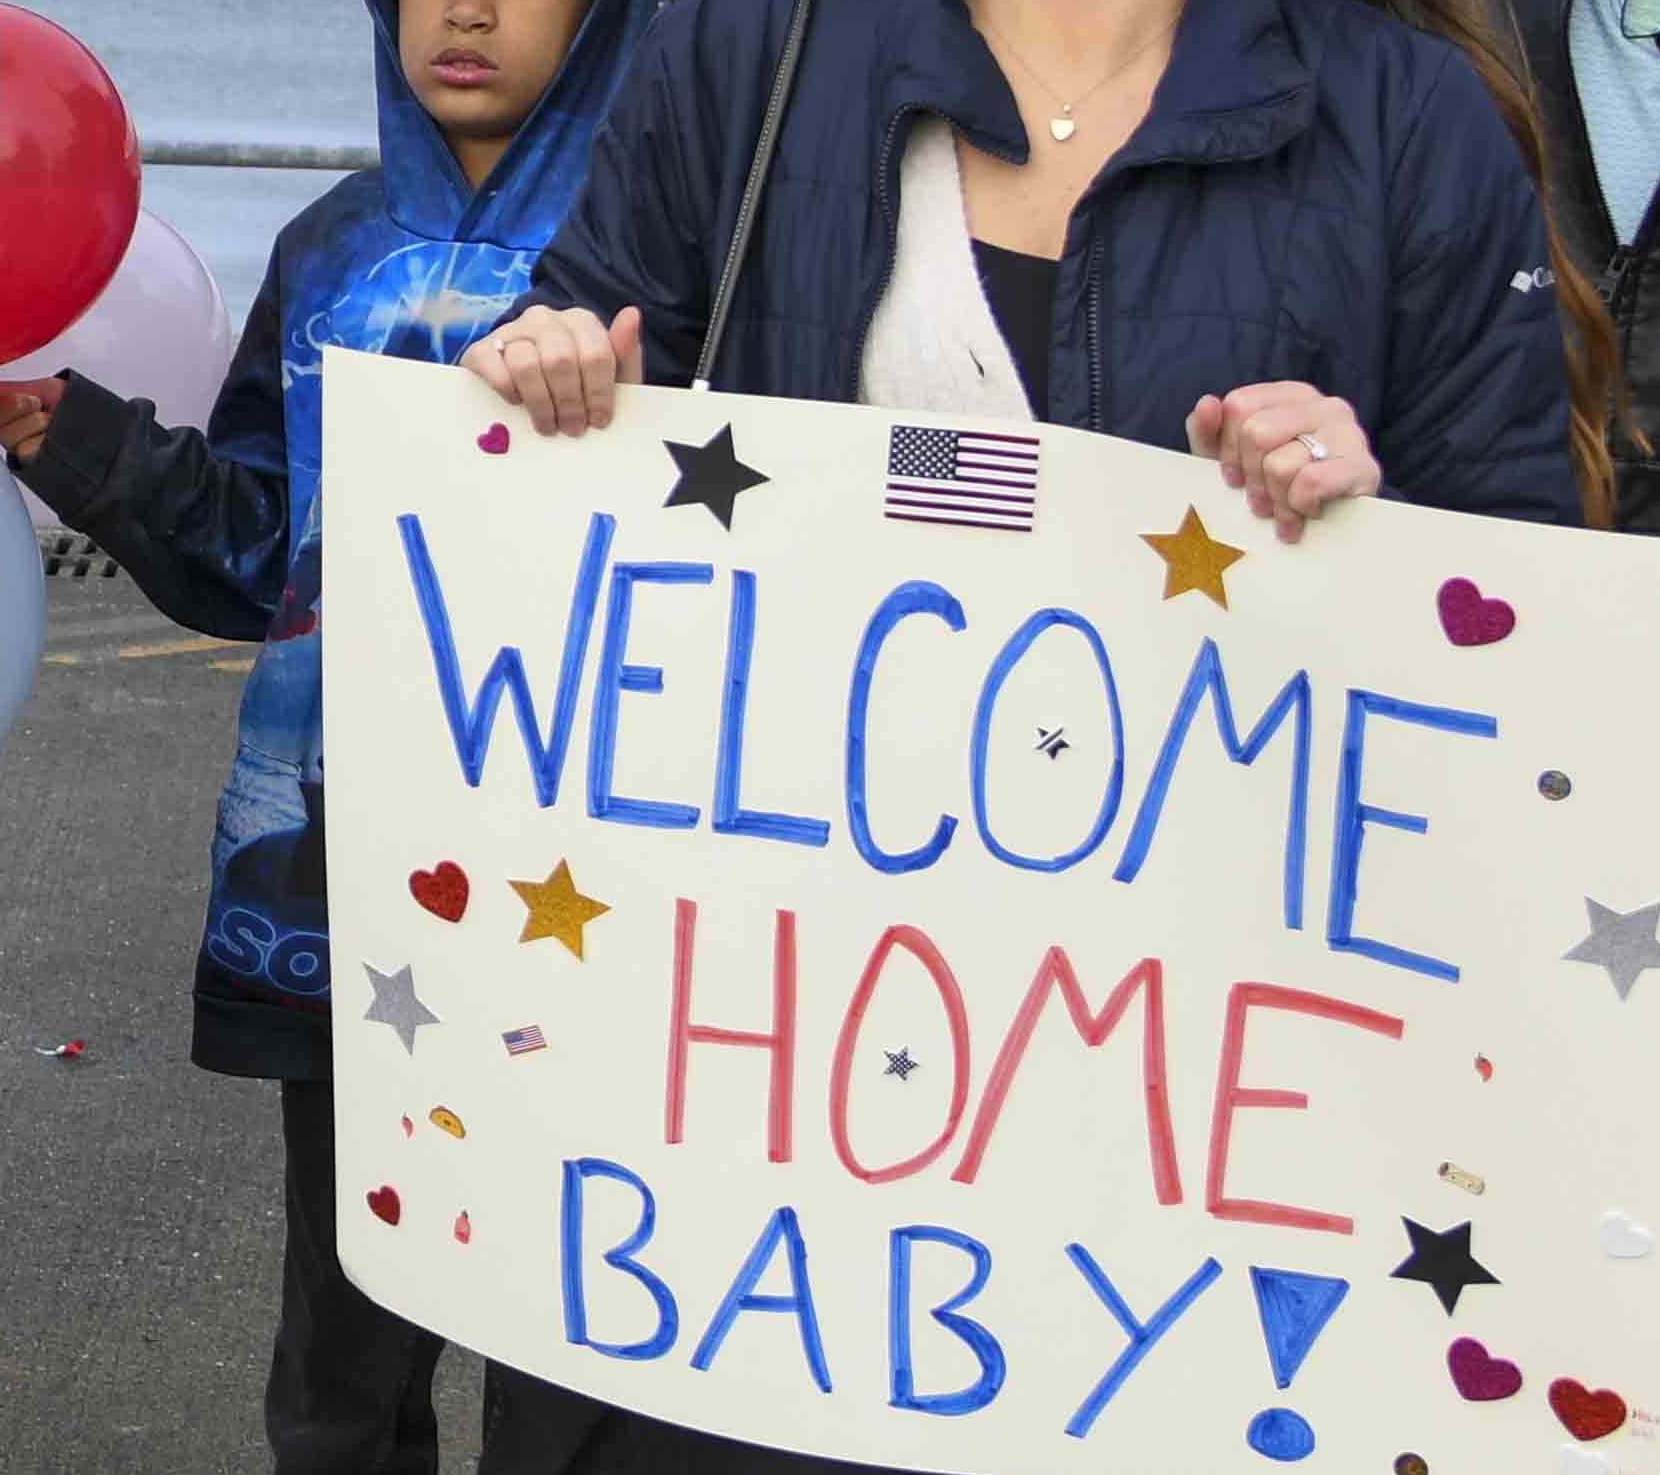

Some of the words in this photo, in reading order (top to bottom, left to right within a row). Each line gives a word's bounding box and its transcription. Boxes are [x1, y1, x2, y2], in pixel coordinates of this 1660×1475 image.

[396, 511, 1498, 983] WELCOME
[664, 897, 1405, 1237] HOME
[561, 1157, 1351, 1463] BABY!
